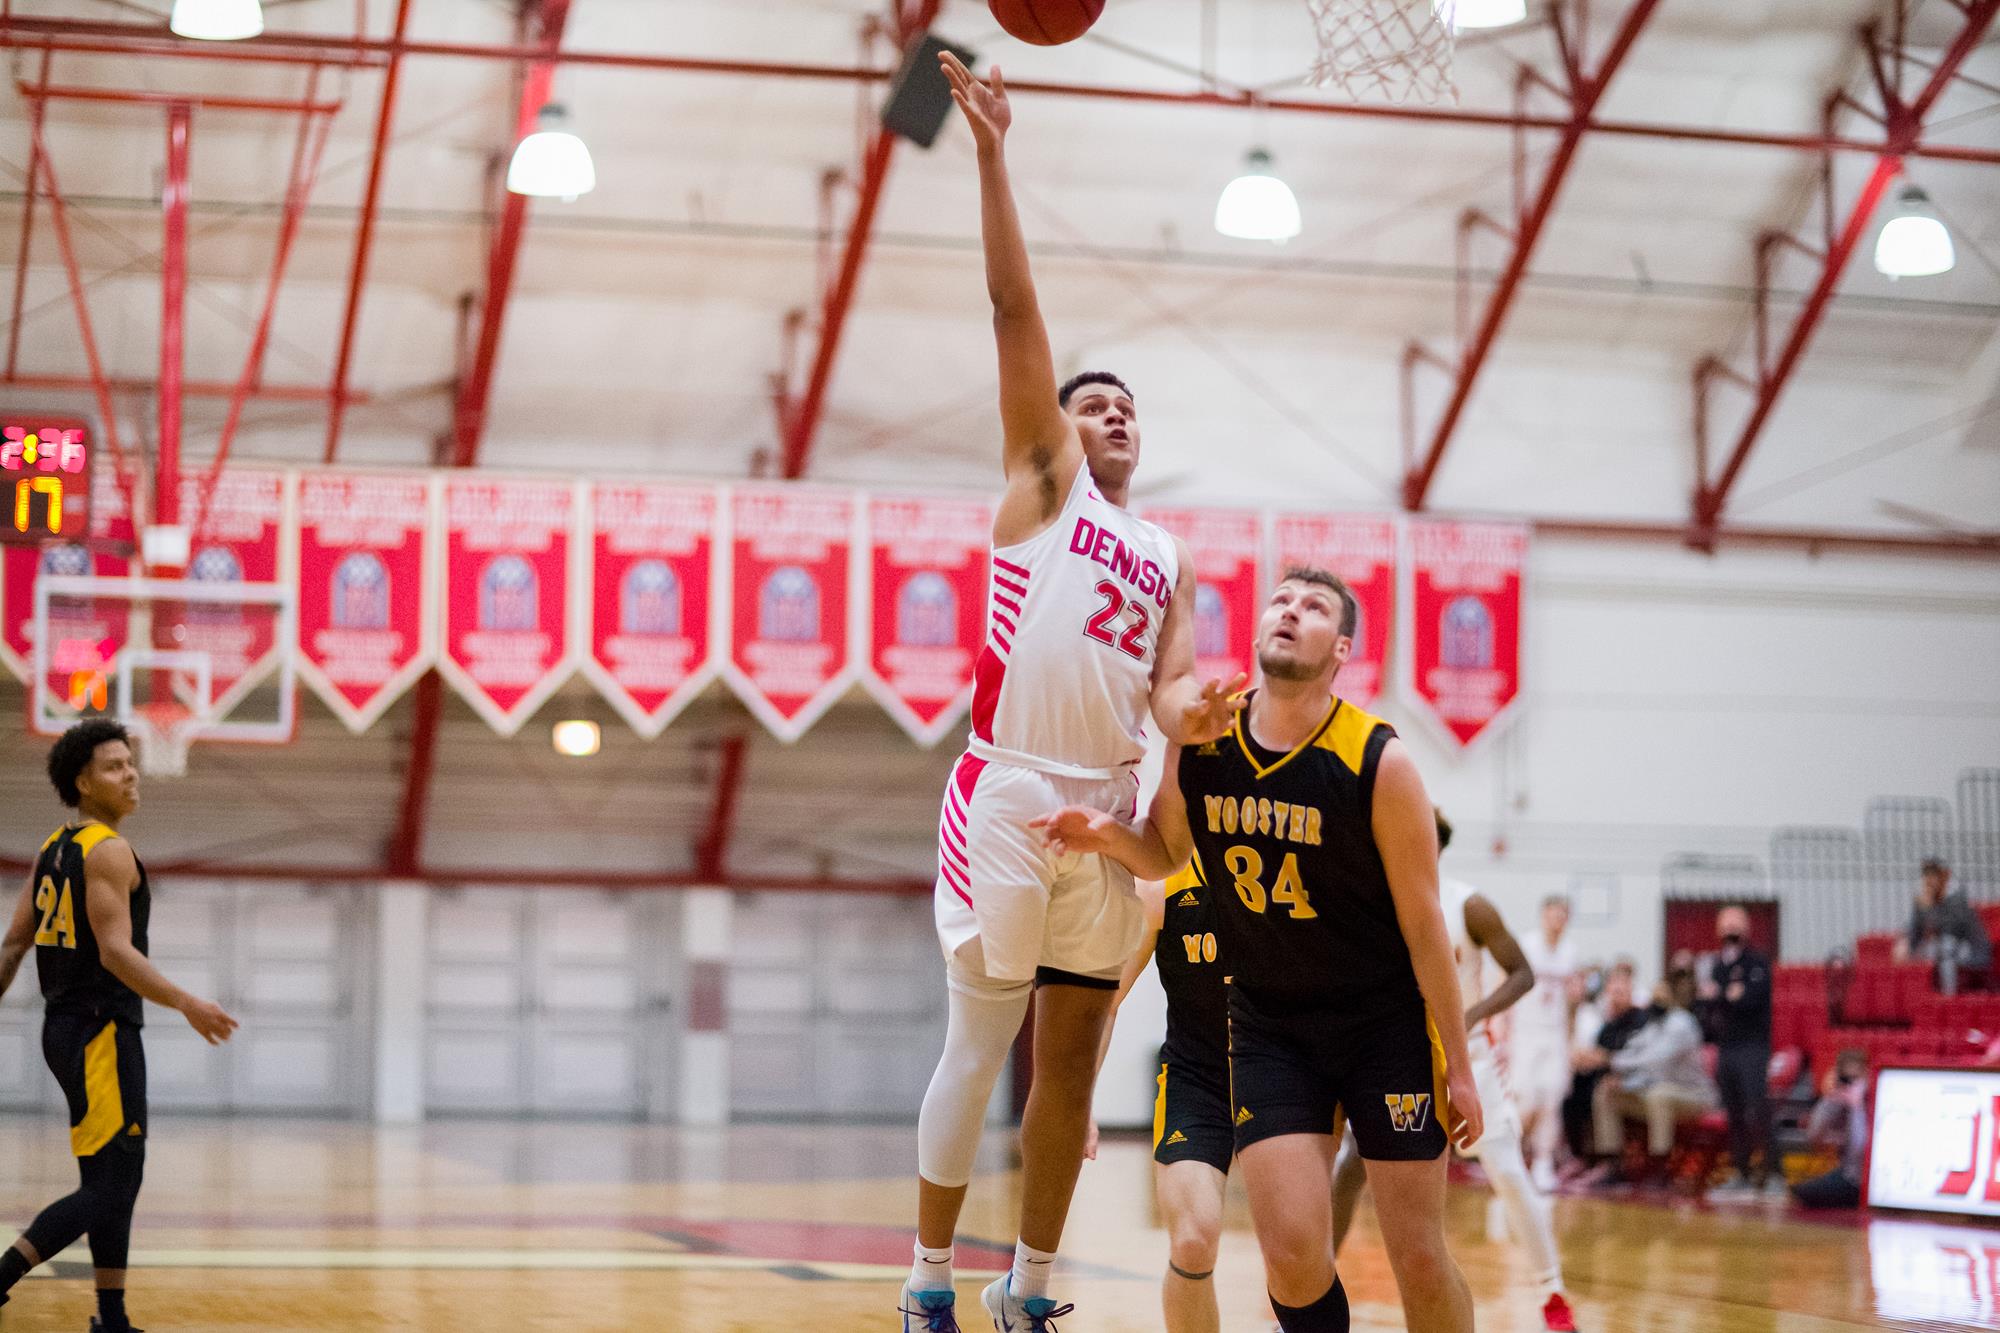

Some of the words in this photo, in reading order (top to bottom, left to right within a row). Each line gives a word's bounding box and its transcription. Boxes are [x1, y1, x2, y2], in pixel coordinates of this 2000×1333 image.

[15, 476, 64, 534] 17
[1069, 516, 1172, 616] DENISO
[1083, 578, 1149, 661] 22
[1203, 794, 1322, 846] WOOSTER
[34, 874, 77, 950] 24
[1224, 844, 1318, 919] 34
[1182, 932, 1217, 964] WO
[1384, 1093, 1431, 1132] W
